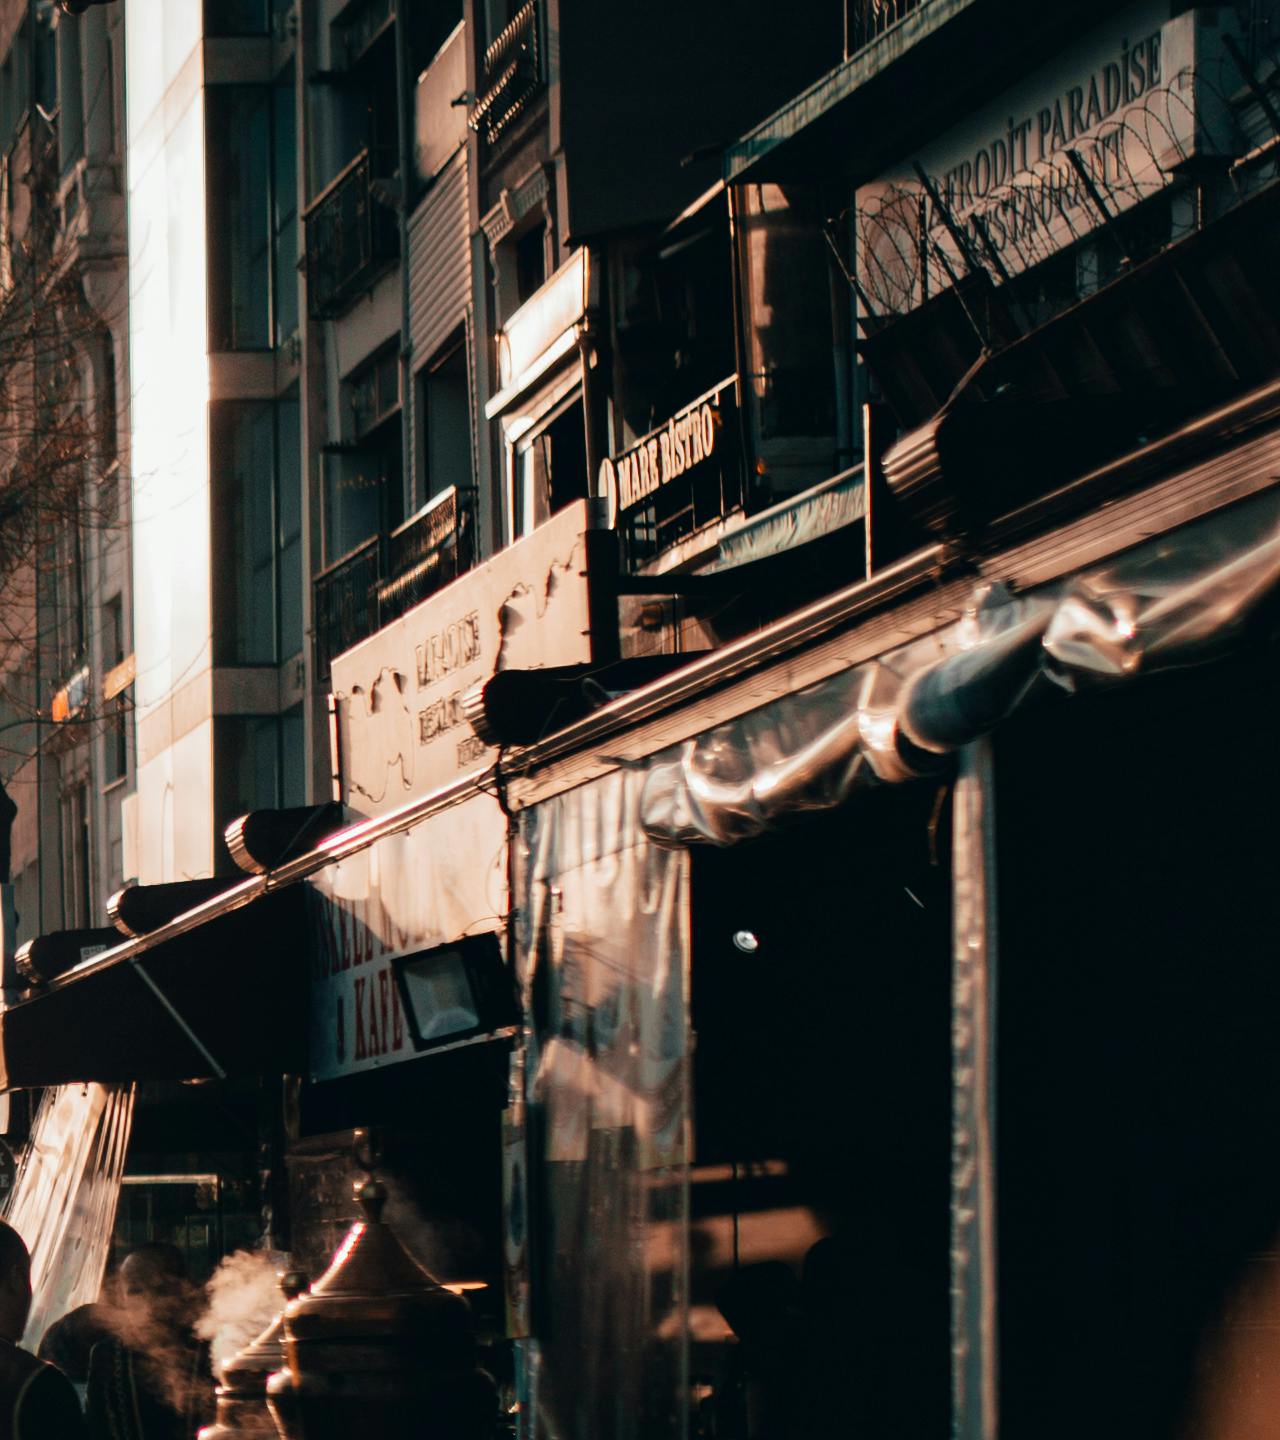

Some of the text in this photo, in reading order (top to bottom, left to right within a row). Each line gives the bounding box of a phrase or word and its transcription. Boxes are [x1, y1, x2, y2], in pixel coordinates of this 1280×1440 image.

[1037, 31, 1163, 159] PARADİSE
[616, 403, 714, 511] MARE BİSTRO
